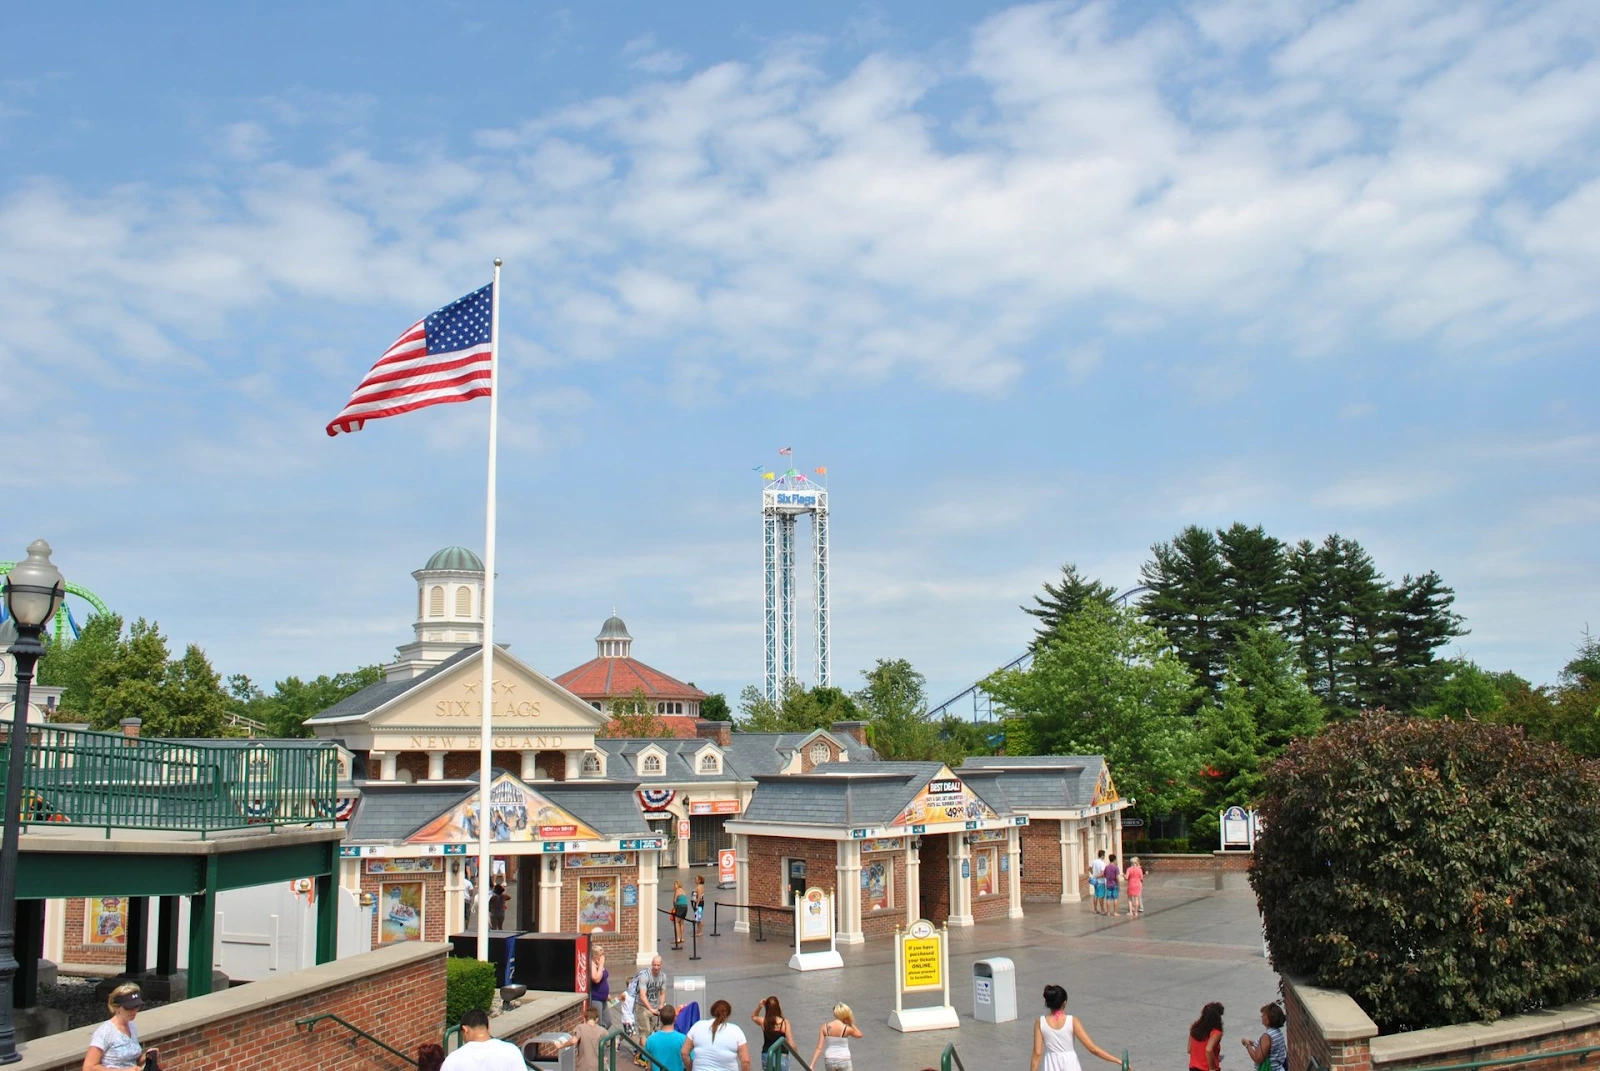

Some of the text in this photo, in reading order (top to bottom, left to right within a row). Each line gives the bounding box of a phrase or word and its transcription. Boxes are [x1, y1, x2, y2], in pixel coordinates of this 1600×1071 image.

[777, 493, 816, 506] Six Flags
[435, 701, 470, 717] SIX
[410, 736, 563, 748] NEW EGLAND
[930, 782, 960, 792] BEST DEAL!
[725, 855, 730, 866] 5
[586, 882, 592, 892] 3
